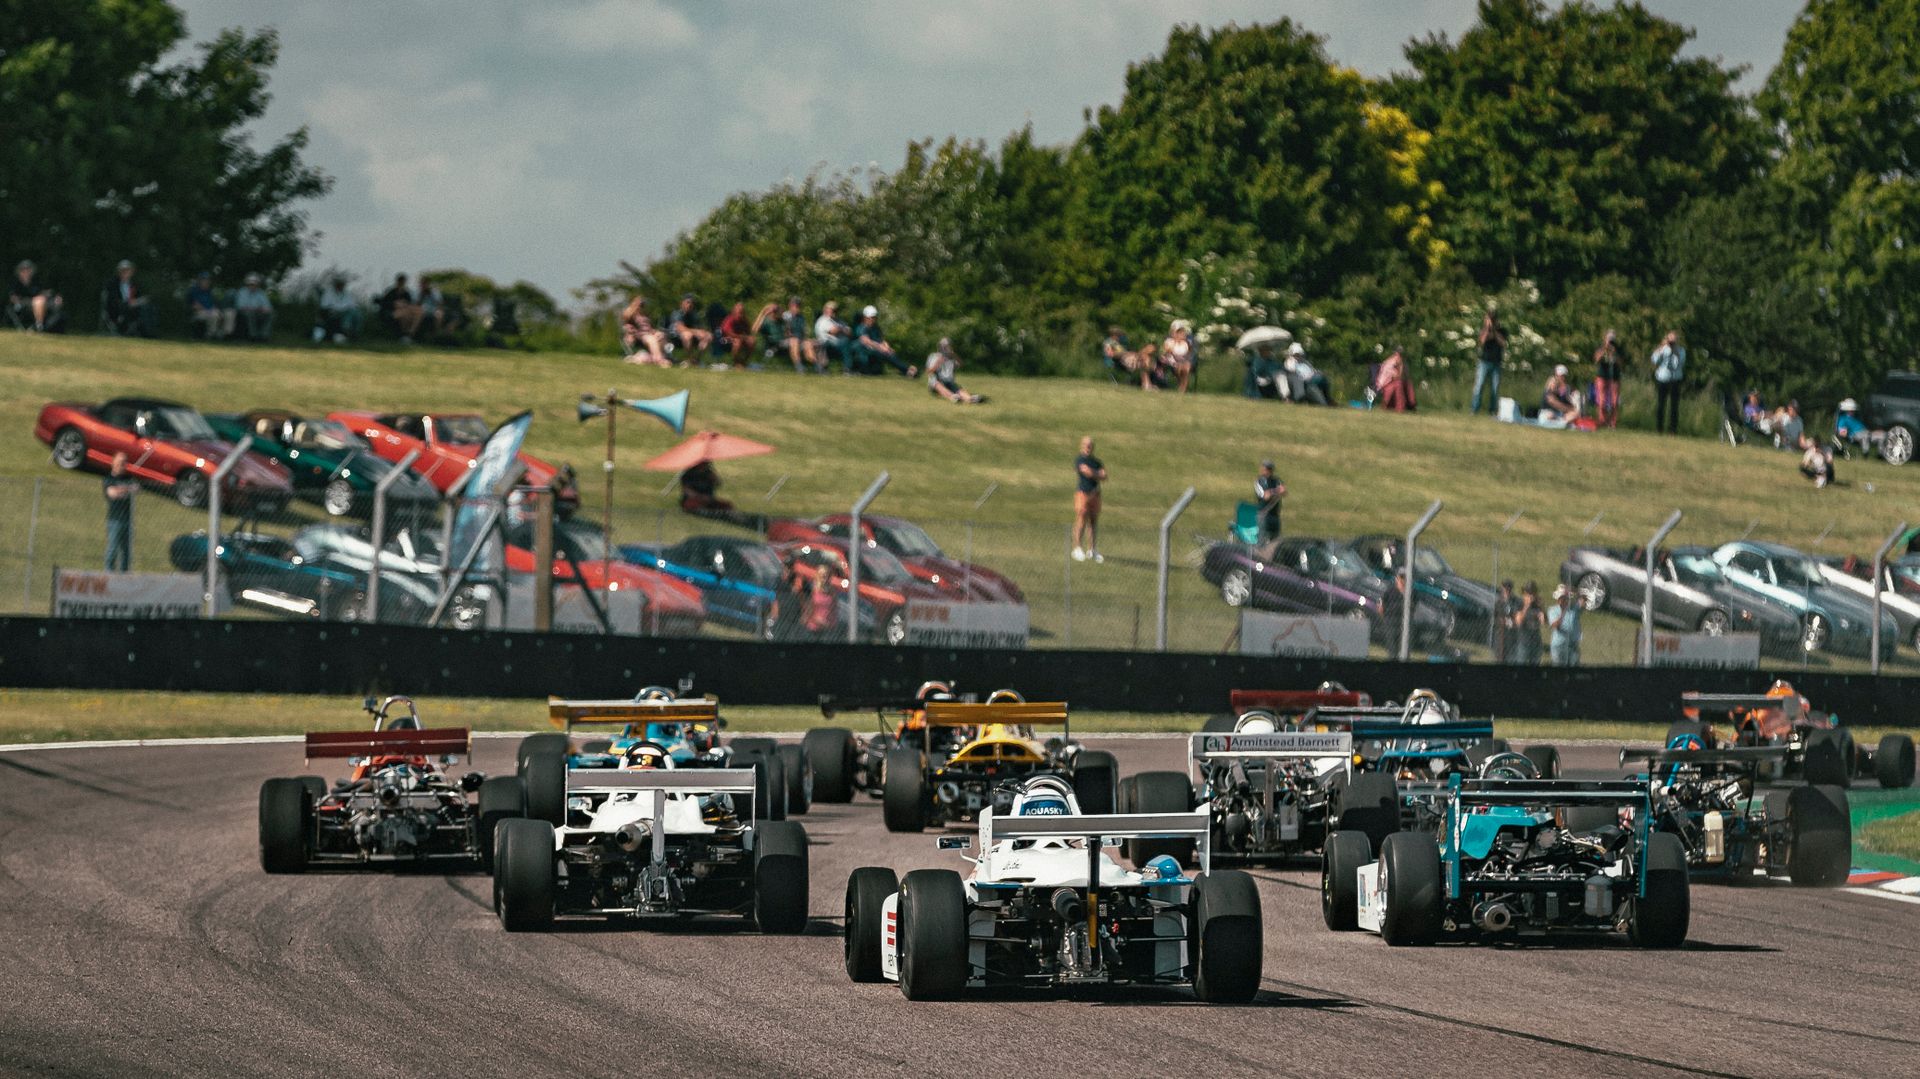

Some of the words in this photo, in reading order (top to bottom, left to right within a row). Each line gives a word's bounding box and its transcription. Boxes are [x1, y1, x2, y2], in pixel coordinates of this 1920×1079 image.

[1231, 737, 1294, 747] Armitstead
[1298, 738, 1340, 747] Barnett
[1026, 807, 1063, 815] AQUASKY
